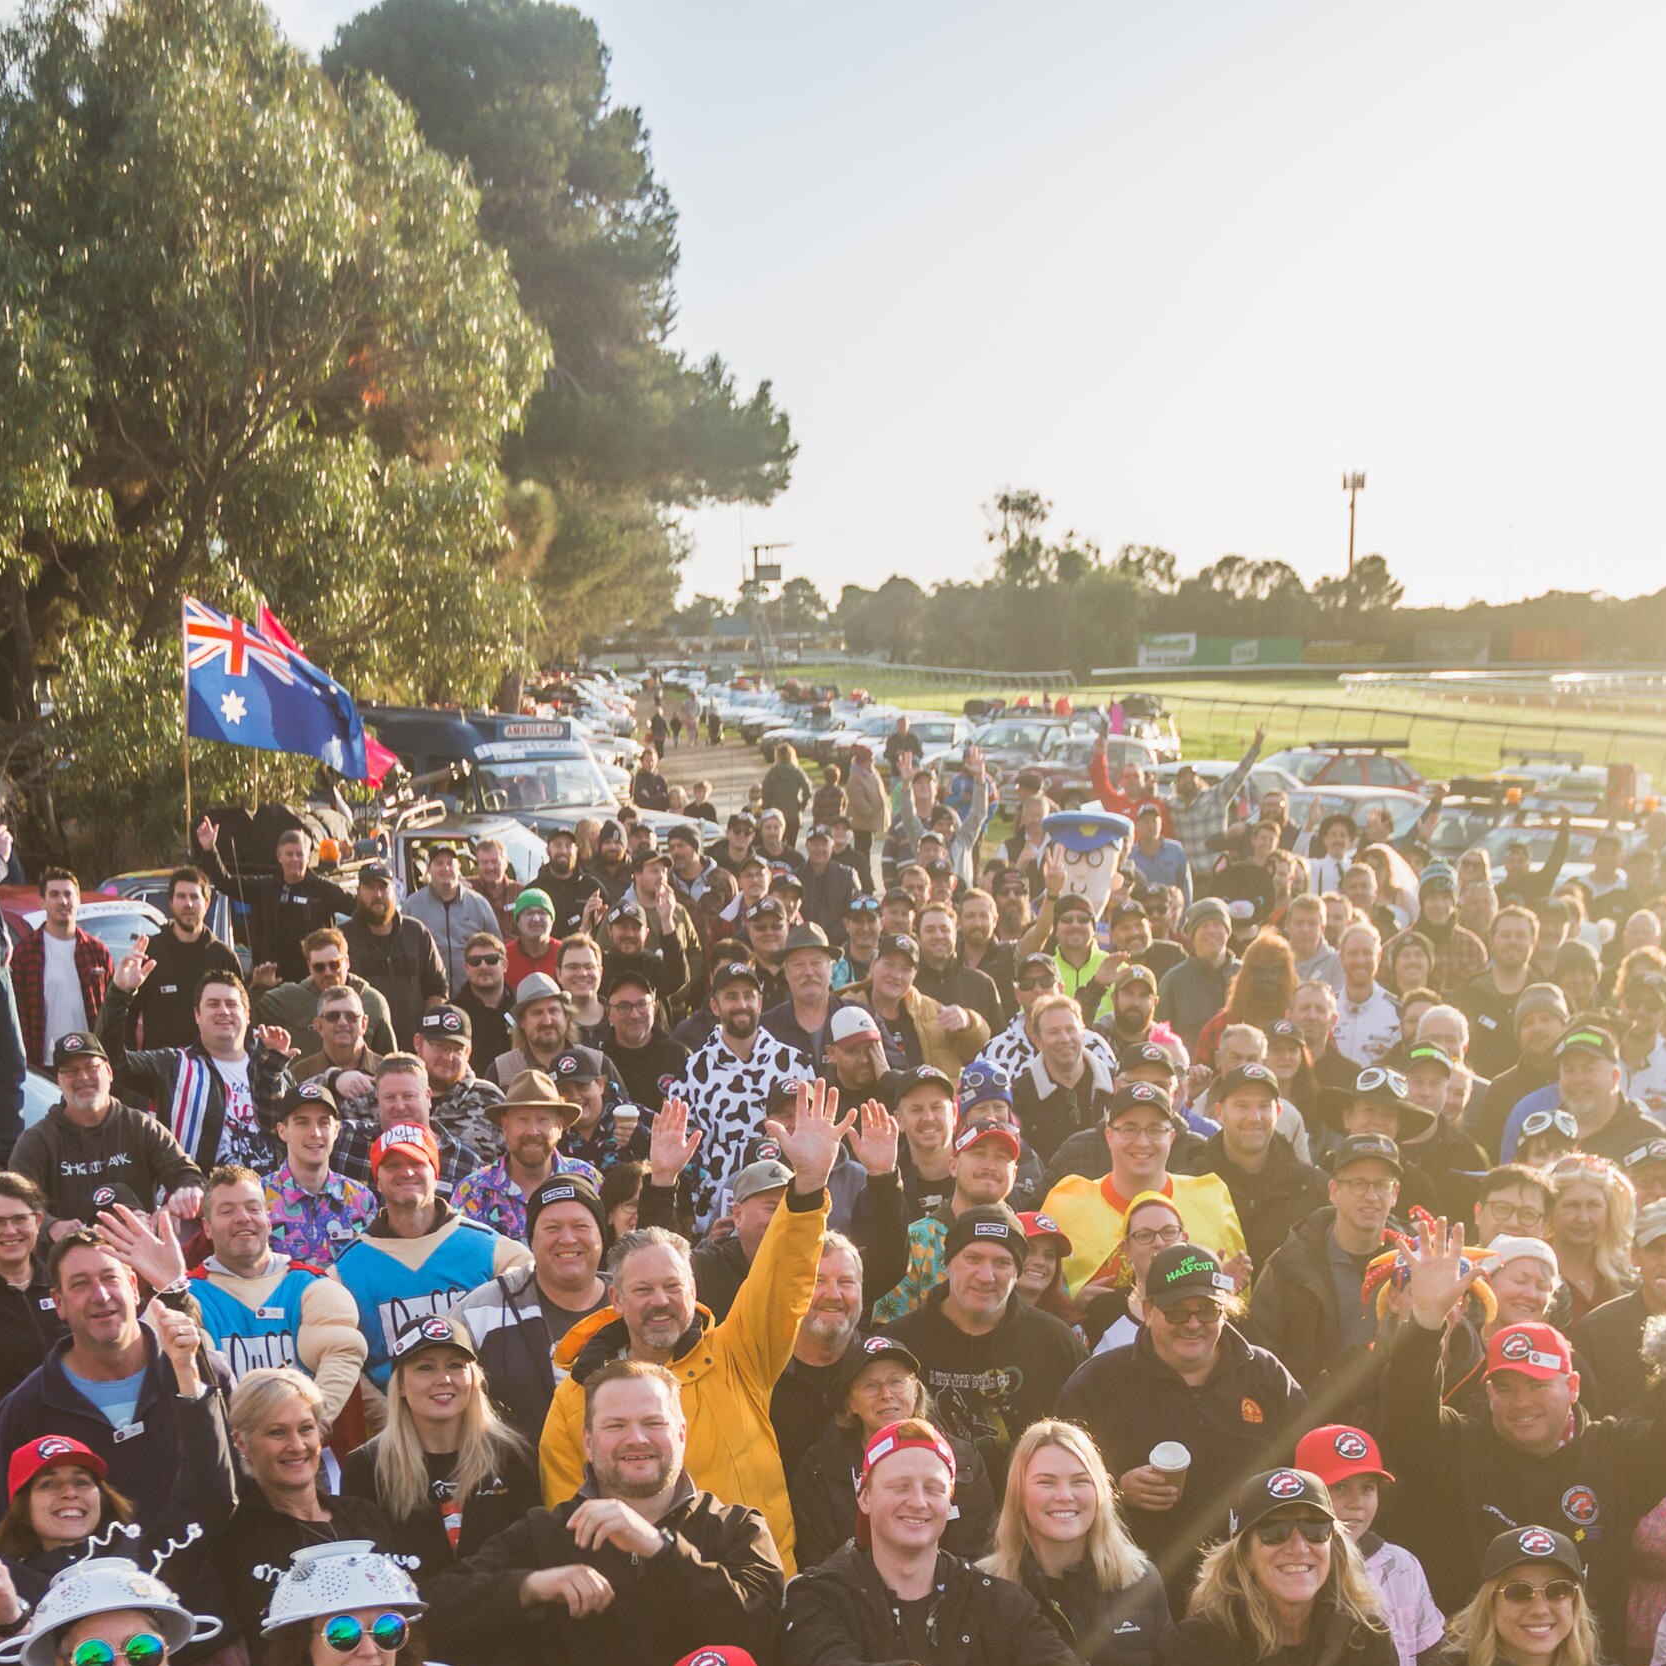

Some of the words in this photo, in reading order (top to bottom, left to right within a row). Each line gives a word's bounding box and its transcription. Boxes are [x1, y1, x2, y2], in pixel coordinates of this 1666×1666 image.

[506, 725, 562, 737] AMBULANCE
[1181, 1256, 1197, 1267] TEAM
[1166, 1261, 1215, 1283] HALFCUT
